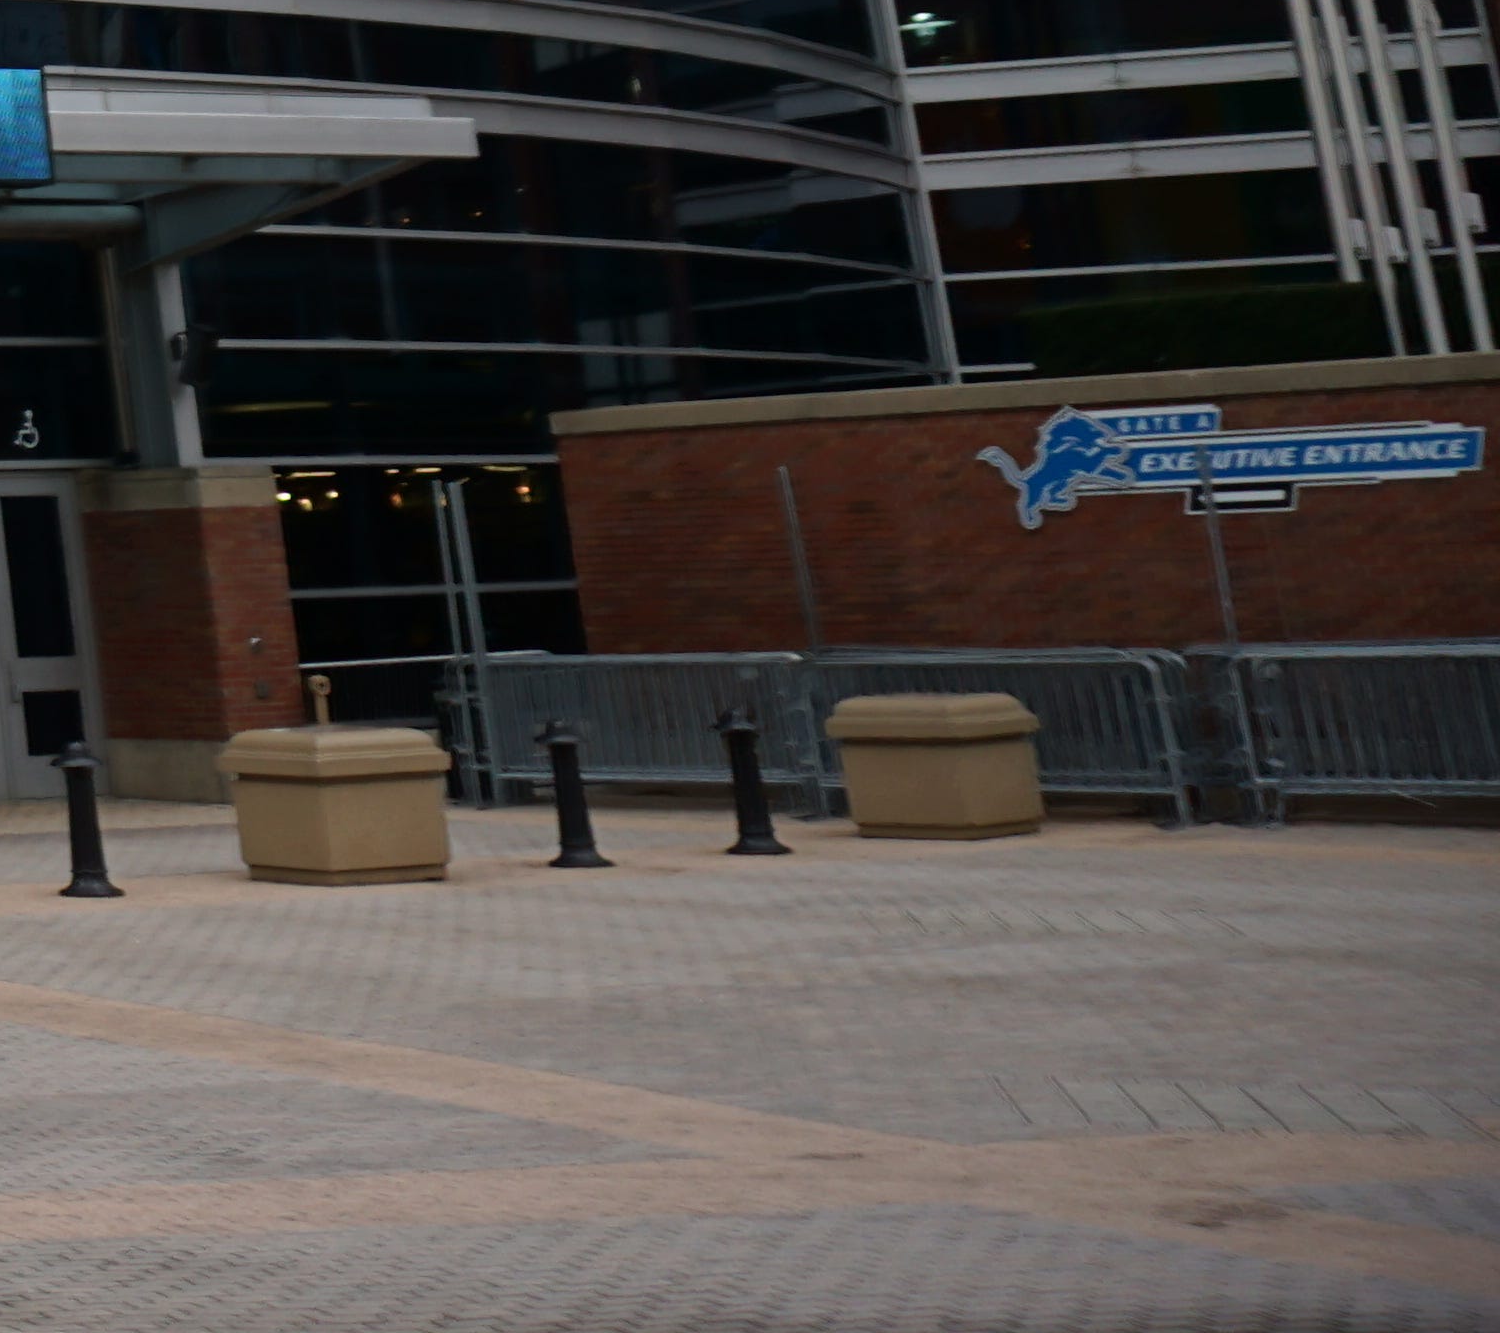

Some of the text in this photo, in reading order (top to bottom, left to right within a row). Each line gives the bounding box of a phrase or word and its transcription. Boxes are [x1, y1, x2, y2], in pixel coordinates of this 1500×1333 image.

[1116, 414, 1212, 433] GATE A
[1139, 436, 1470, 474] EXEUTIVE ENTRANCE
